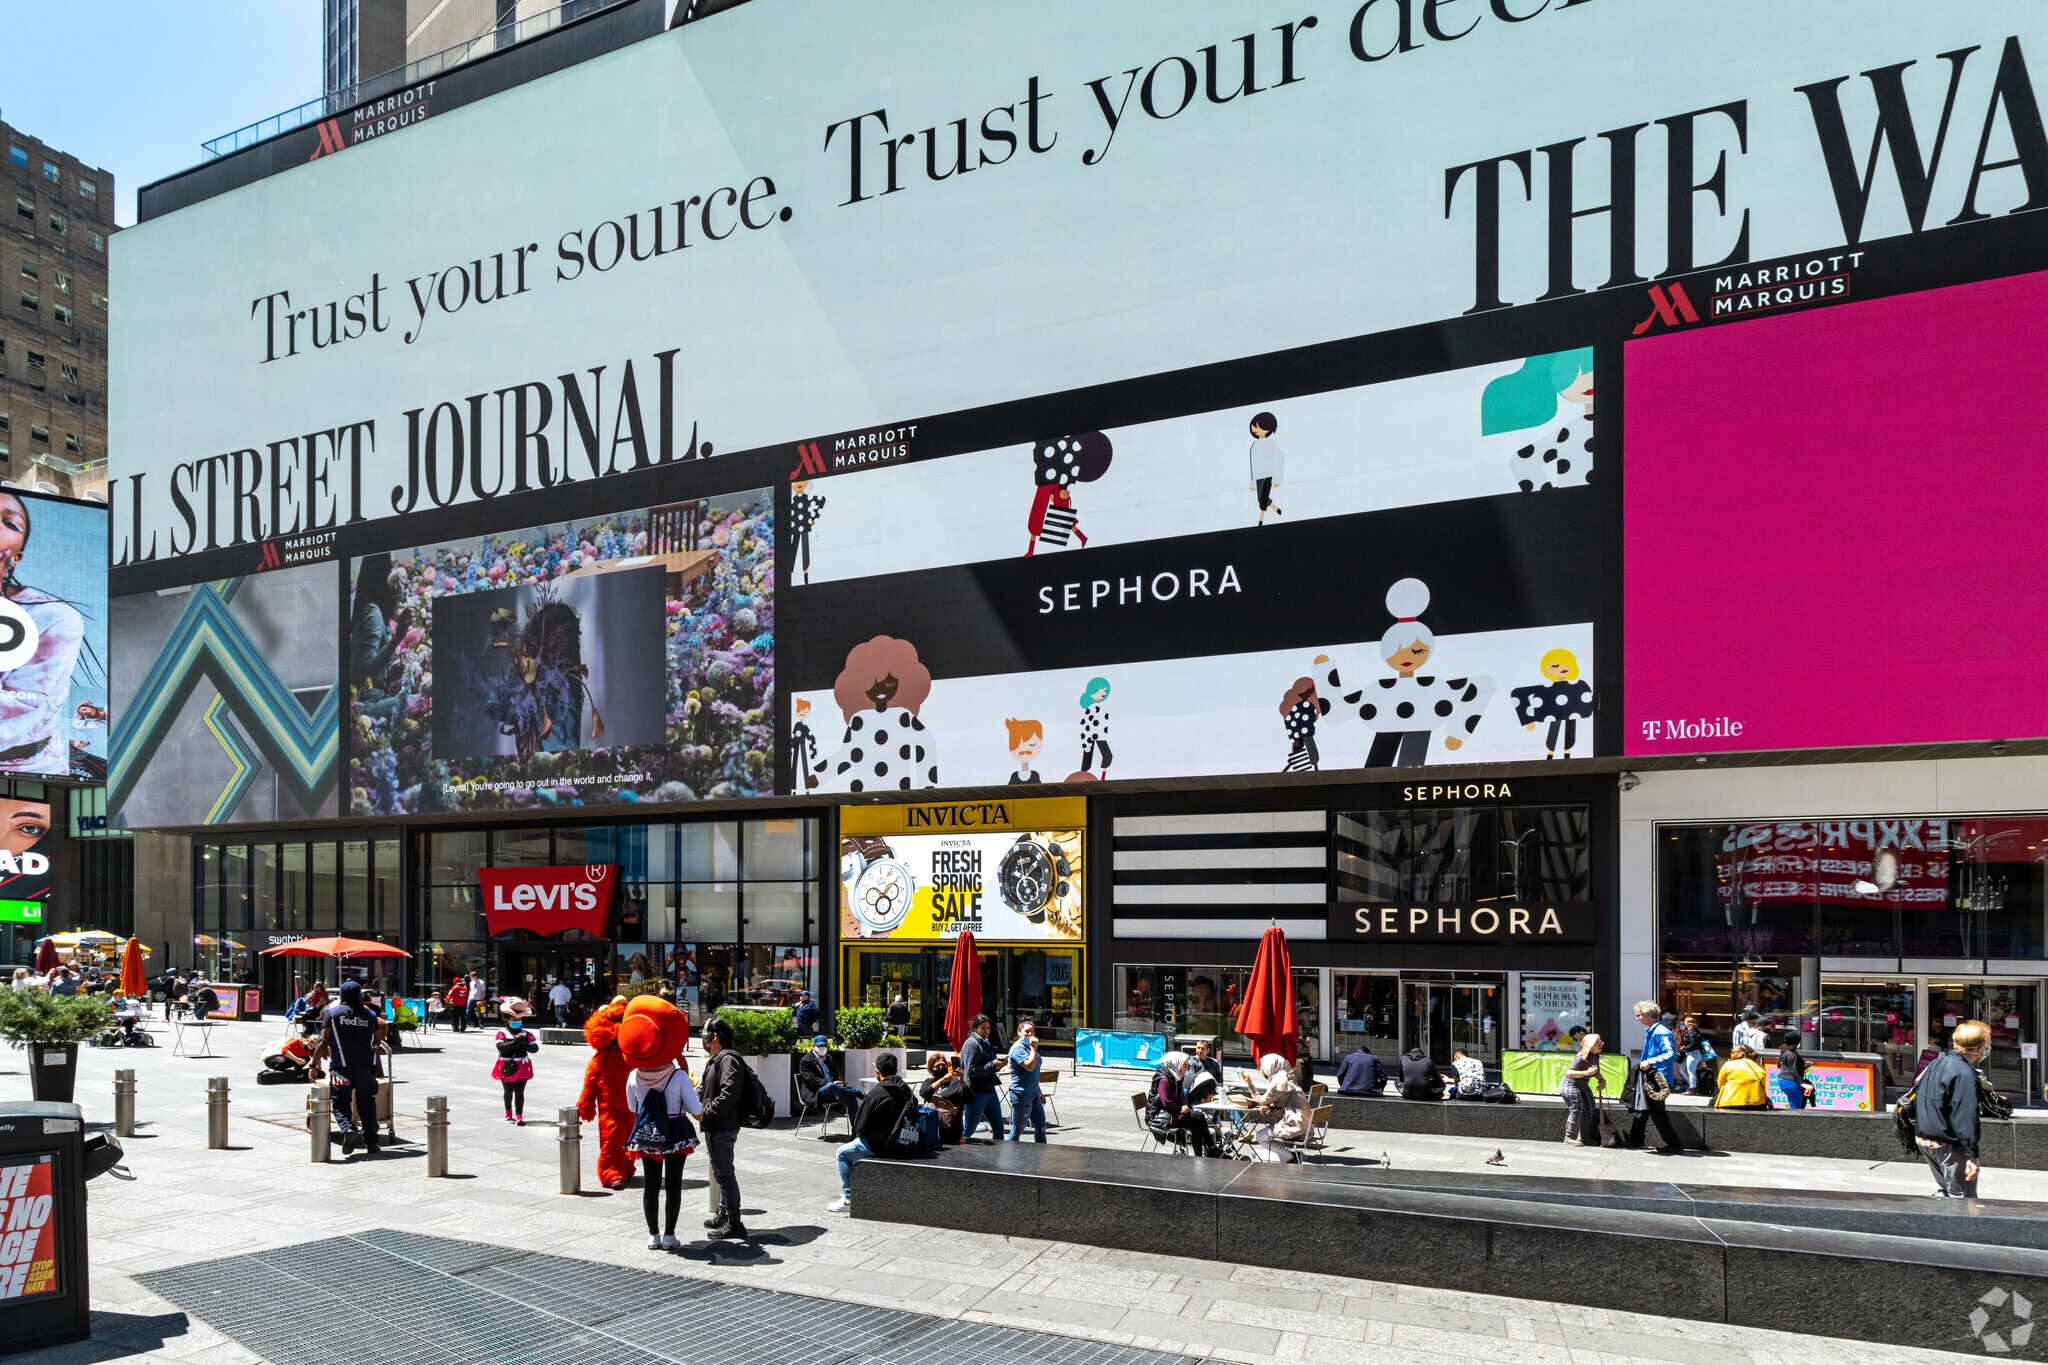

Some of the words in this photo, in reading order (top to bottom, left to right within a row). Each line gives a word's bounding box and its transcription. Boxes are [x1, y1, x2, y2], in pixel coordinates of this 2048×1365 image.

[353, 82, 437, 122] MARRIOTT
[823, 75, 1058, 208] Trust
[1082, 15, 1318, 166] your
[353, 104, 427, 144] MARQUIS
[1444, 98, 1751, 317] THE
[1793, 35, 2048, 245] WA
[251, 272, 391, 365] Trust
[404, 241, 540, 345] your
[556, 173, 794, 283] source.
[1715, 251, 1865, 292] MARRIOTT
[1715, 277, 1847, 315] MARQUIS
[834, 425, 918, 451] MARRIOTT
[170, 419, 375, 556] STREET
[391, 347, 714, 515] JOURNAL.
[834, 443, 908, 468] MARQUIS
[284, 531, 337, 550] MARRIOTT
[284, 546, 331, 563] MARQUIS
[1039, 564, 1242, 614] SEPHORA
[1665, 716, 1744, 739] Mobile
[442, 783, 469, 794] [Leyna]
[471, 781, 493, 791] You're
[494, 781, 515, 792] going
[516, 781, 524, 789] to
[525, 781, 536, 790] go
[537, 779, 549, 787] out
[550, 777, 558, 786] in
[560, 776, 572, 786] the
[574, 774, 595, 785] world
[597, 774, 612, 784] and
[613, 772, 645, 784] change
[645, 771, 653, 782] it,
[1404, 783, 1512, 801] SEPHORA
[906, 803, 1011, 828] INVICTA
[941, 839, 972, 847] INVICTA
[932, 850, 982, 874] FRESH
[932, 873, 982, 893] SPRING
[932, 893, 983, 922] SALE
[932, 923, 944, 932] BUY
[951, 923, 962, 932] GET
[968, 923, 983, 932] FREE
[1355, 907, 1563, 935] SEPHORA
[1533, 992, 1578, 1000] SEPHORA
[1543, 1000, 1560, 1008] THE
[1841, 1084, 1864, 1092] FOR
[7, 1195, 53, 1231] NO
[28, 1269, 55, 1282] ASIAN
[31, 1260, 54, 1272] STOP
[24, 1281, 47, 1294] HATE
